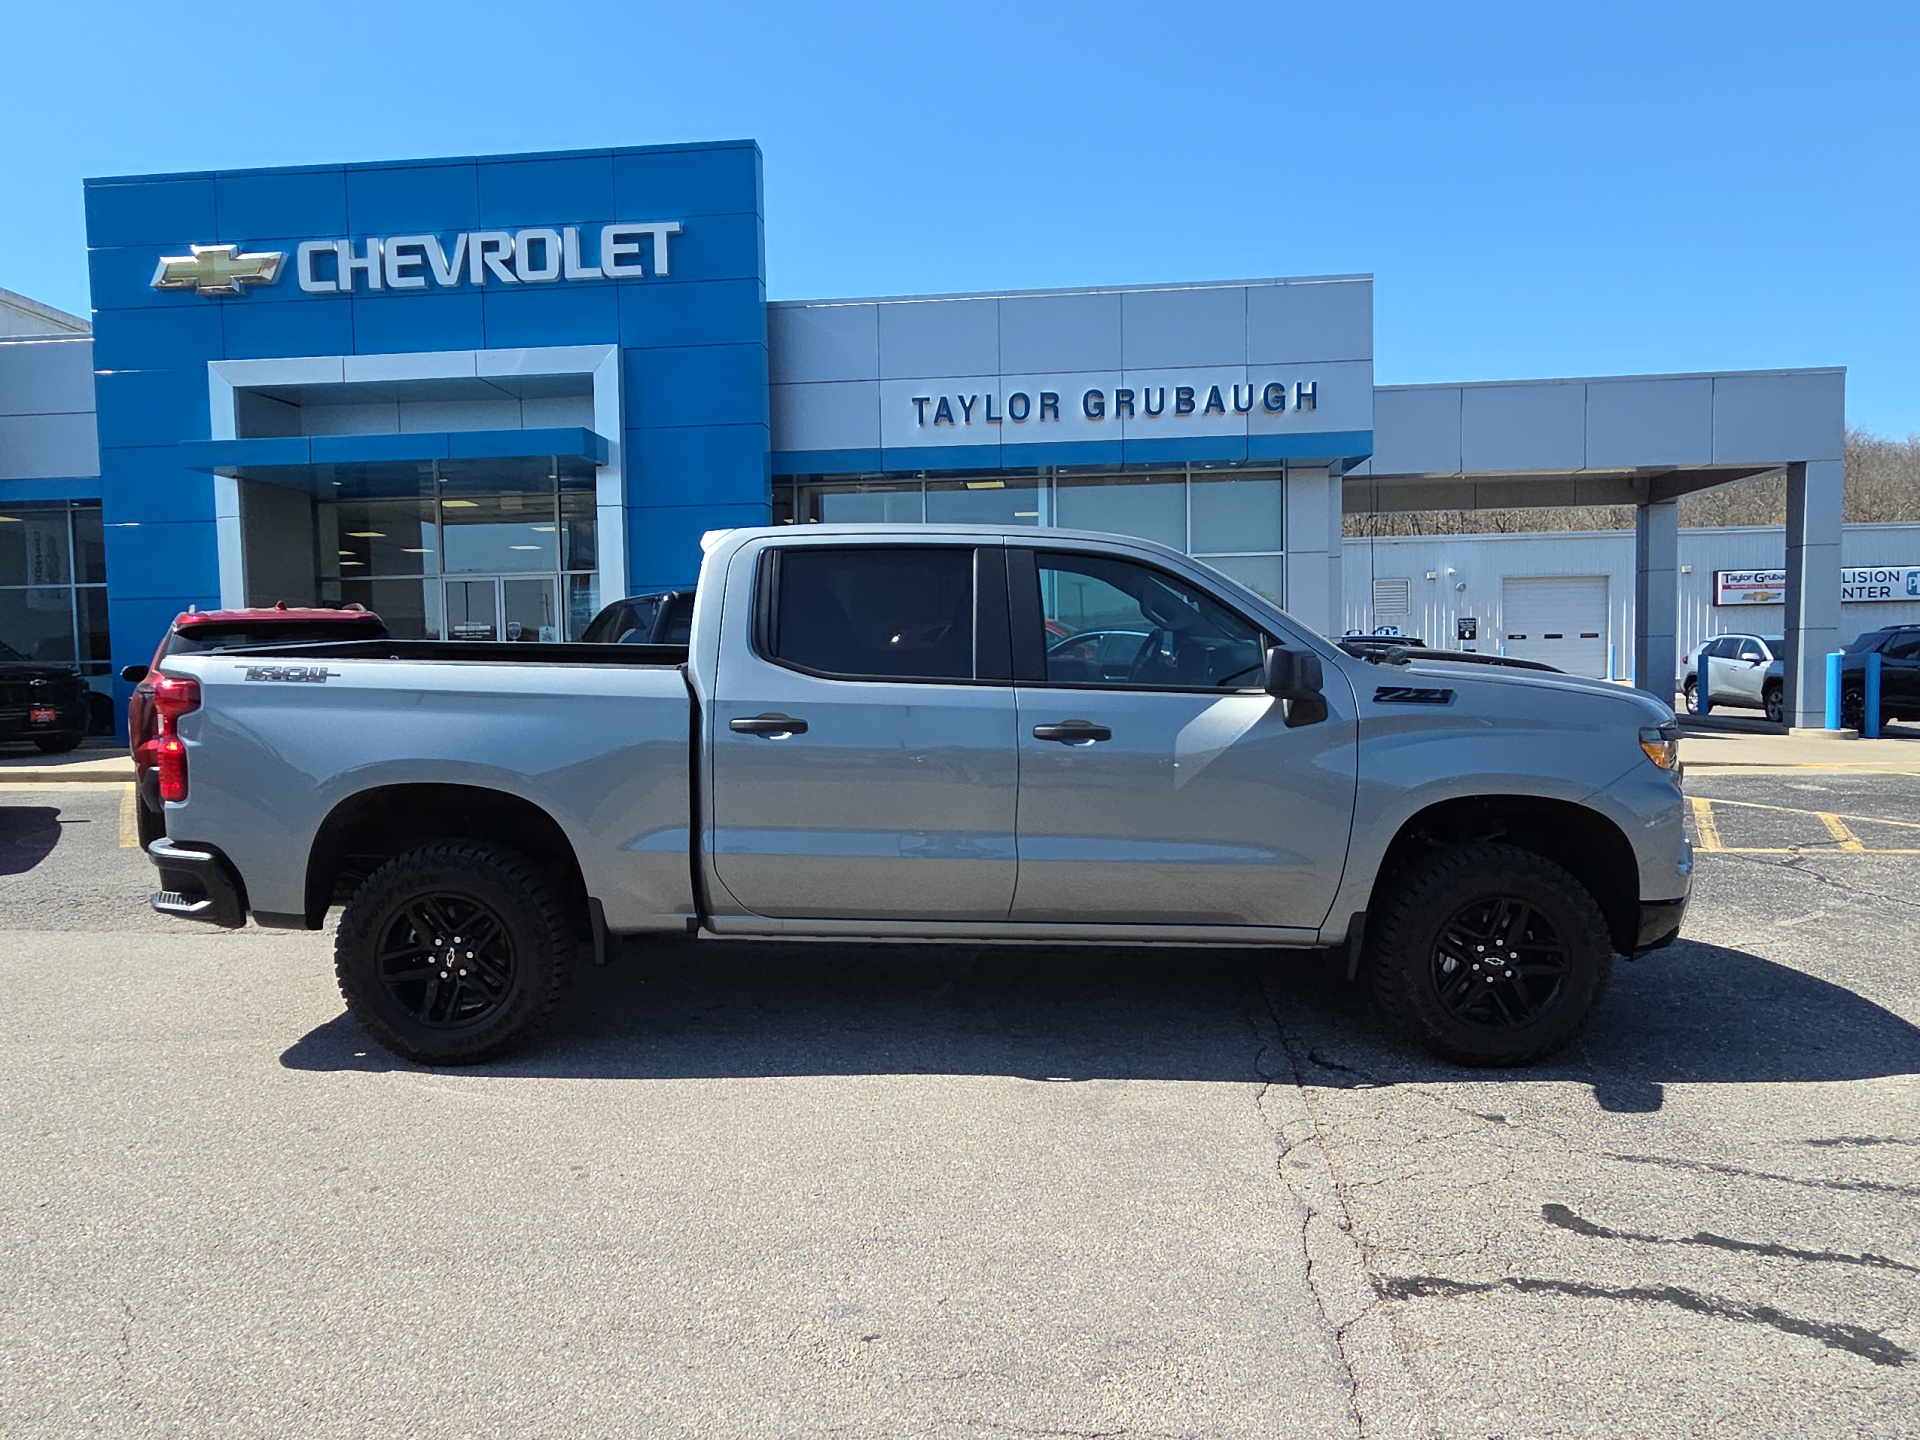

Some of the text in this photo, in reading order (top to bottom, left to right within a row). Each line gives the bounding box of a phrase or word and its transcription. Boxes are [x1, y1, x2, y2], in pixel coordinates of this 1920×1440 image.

[298, 222, 682, 293] CHEVROLET
[911, 380, 1318, 426] TAYLOR GRUBAUGH
[1722, 572, 1785, 583] Taylor Gruba
[1842, 570, 1900, 584] LISION
[1842, 586, 1891, 599] NTER
[1372, 686, 1455, 704] Z71
